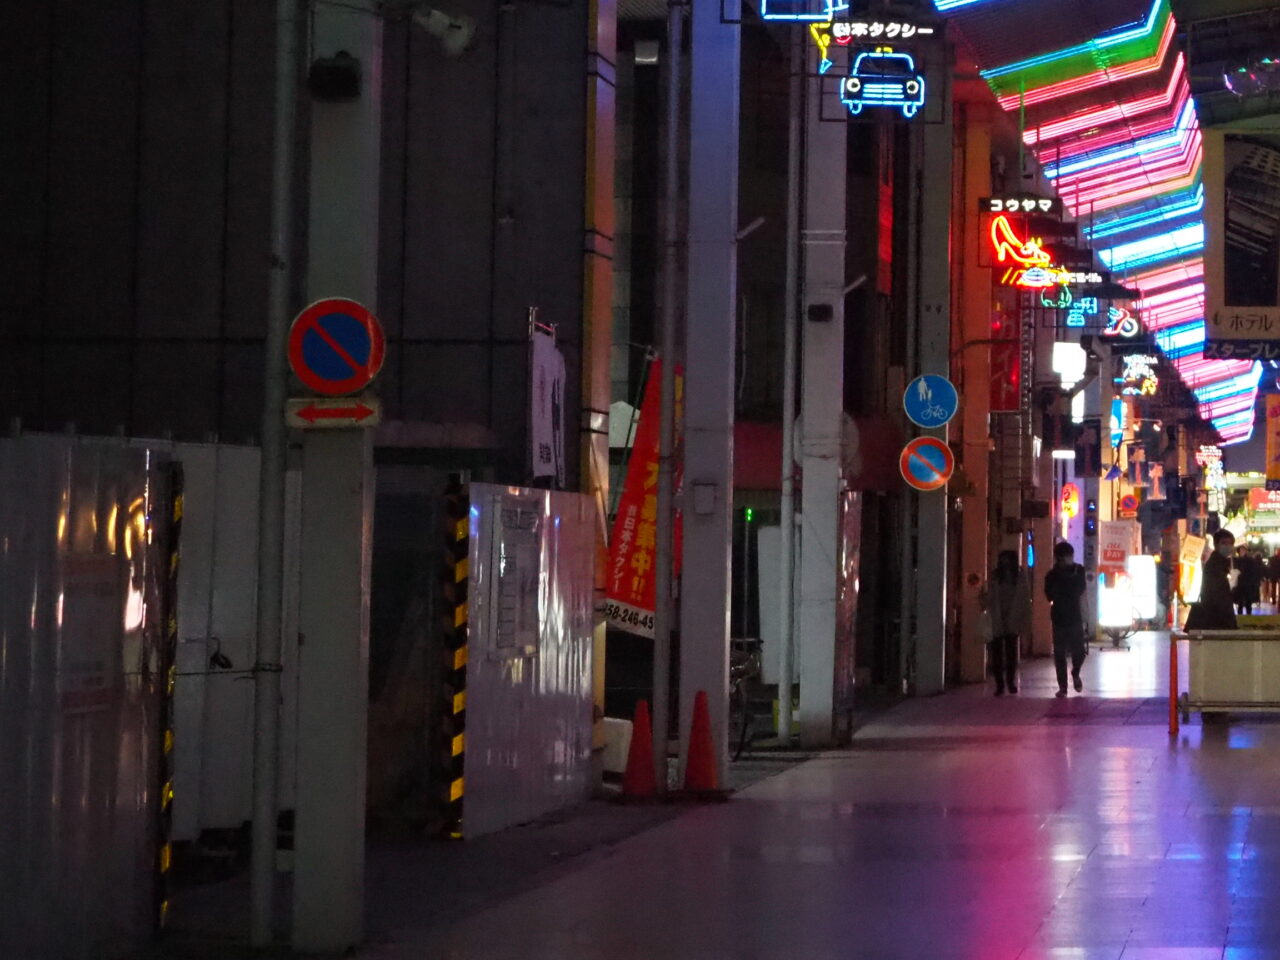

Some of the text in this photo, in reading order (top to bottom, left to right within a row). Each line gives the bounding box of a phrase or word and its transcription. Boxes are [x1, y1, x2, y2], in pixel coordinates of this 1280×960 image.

[990, 199, 1052, 211] コウヤマ
[1231, 314, 1273, 331] ホテル
[606, 604, 655, 630] 58-246-45
